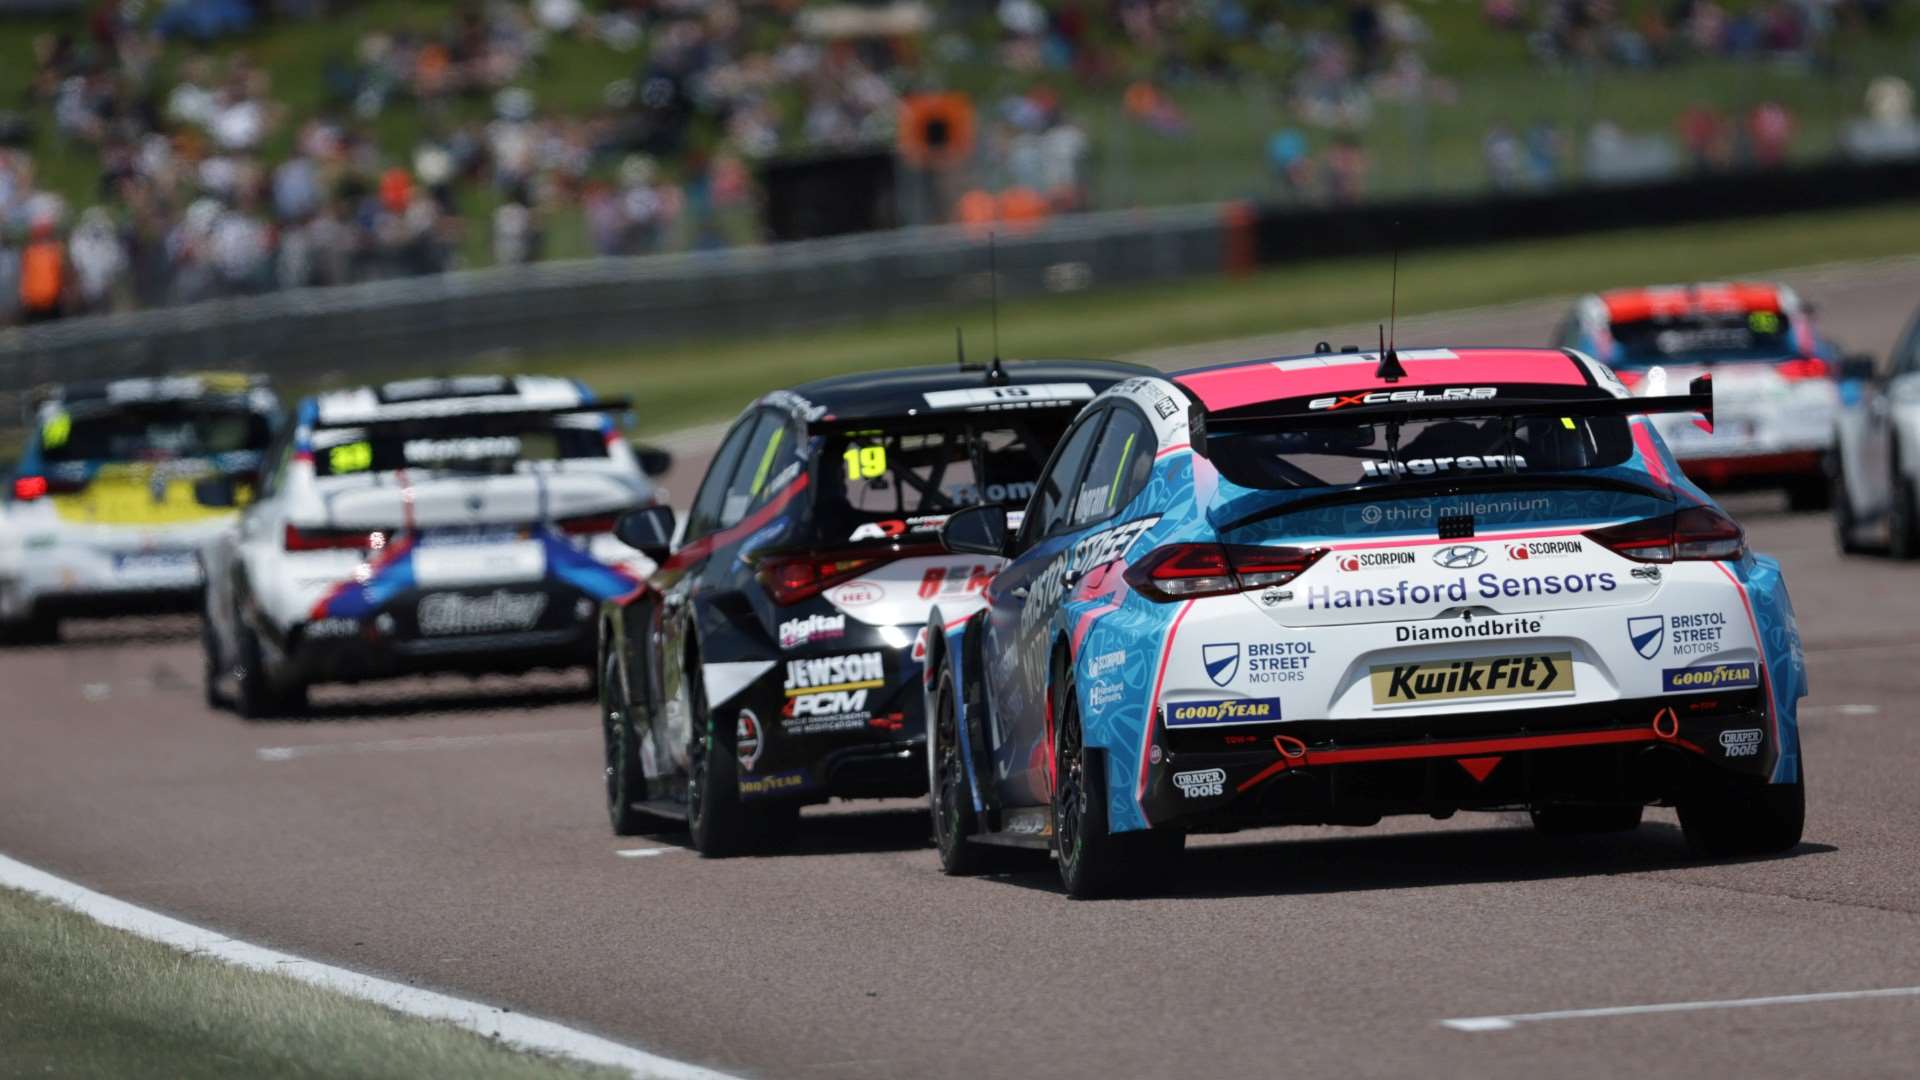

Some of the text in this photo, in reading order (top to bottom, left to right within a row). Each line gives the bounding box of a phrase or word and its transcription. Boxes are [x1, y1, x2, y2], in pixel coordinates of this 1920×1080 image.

[843, 446, 886, 480] 19
[1361, 453, 1527, 477] Ingram
[1386, 498, 1550, 521] third millennium
[1529, 541, 1582, 555] SCORPION
[1361, 552, 1415, 566] SCORPION
[1308, 571, 1616, 609] Hansford Sensors
[1671, 613, 1726, 628] BRISTOL
[1396, 617, 1541, 642] Diamondbrite
[1673, 627, 1722, 643] STREET
[1249, 641, 1316, 656] BRISTOL
[1673, 642, 1720, 655] MOTORS
[784, 652, 884, 689] JEWSON
[1249, 656, 1310, 670] STREET
[1249, 671, 1304, 683] MOTORS
[1672, 666, 1750, 686] GOODYEAR
[793, 689, 868, 717] PCM
[1175, 702, 1269, 721] GOODYEAR
[1724, 732, 1760, 743] DRAPER
[1178, 773, 1221, 786] DRAPER
